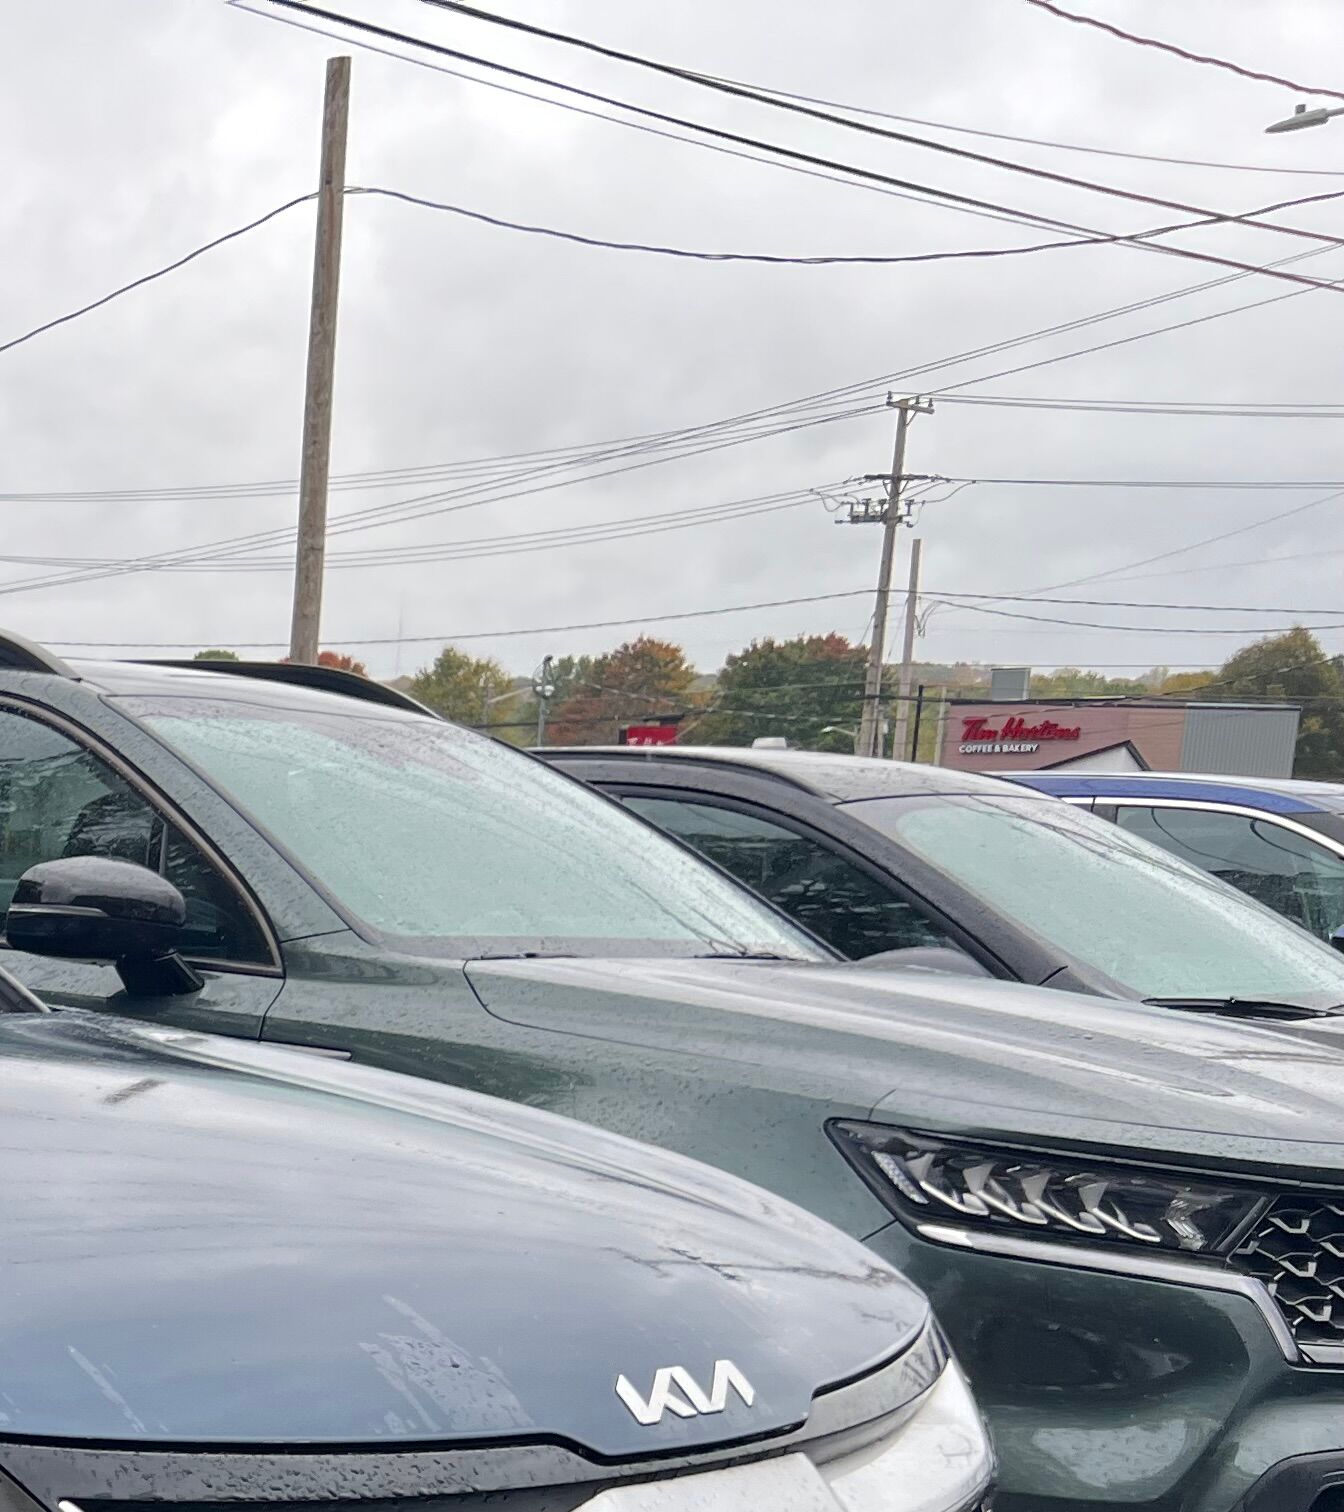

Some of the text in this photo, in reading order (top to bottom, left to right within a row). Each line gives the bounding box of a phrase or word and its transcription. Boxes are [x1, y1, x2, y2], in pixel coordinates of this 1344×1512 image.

[961, 716, 998, 742] Tim
[958, 744, 994, 754] COFFEE
[1002, 743, 1039, 753] BAKERY
[615, 1359, 755, 1425] KIA
